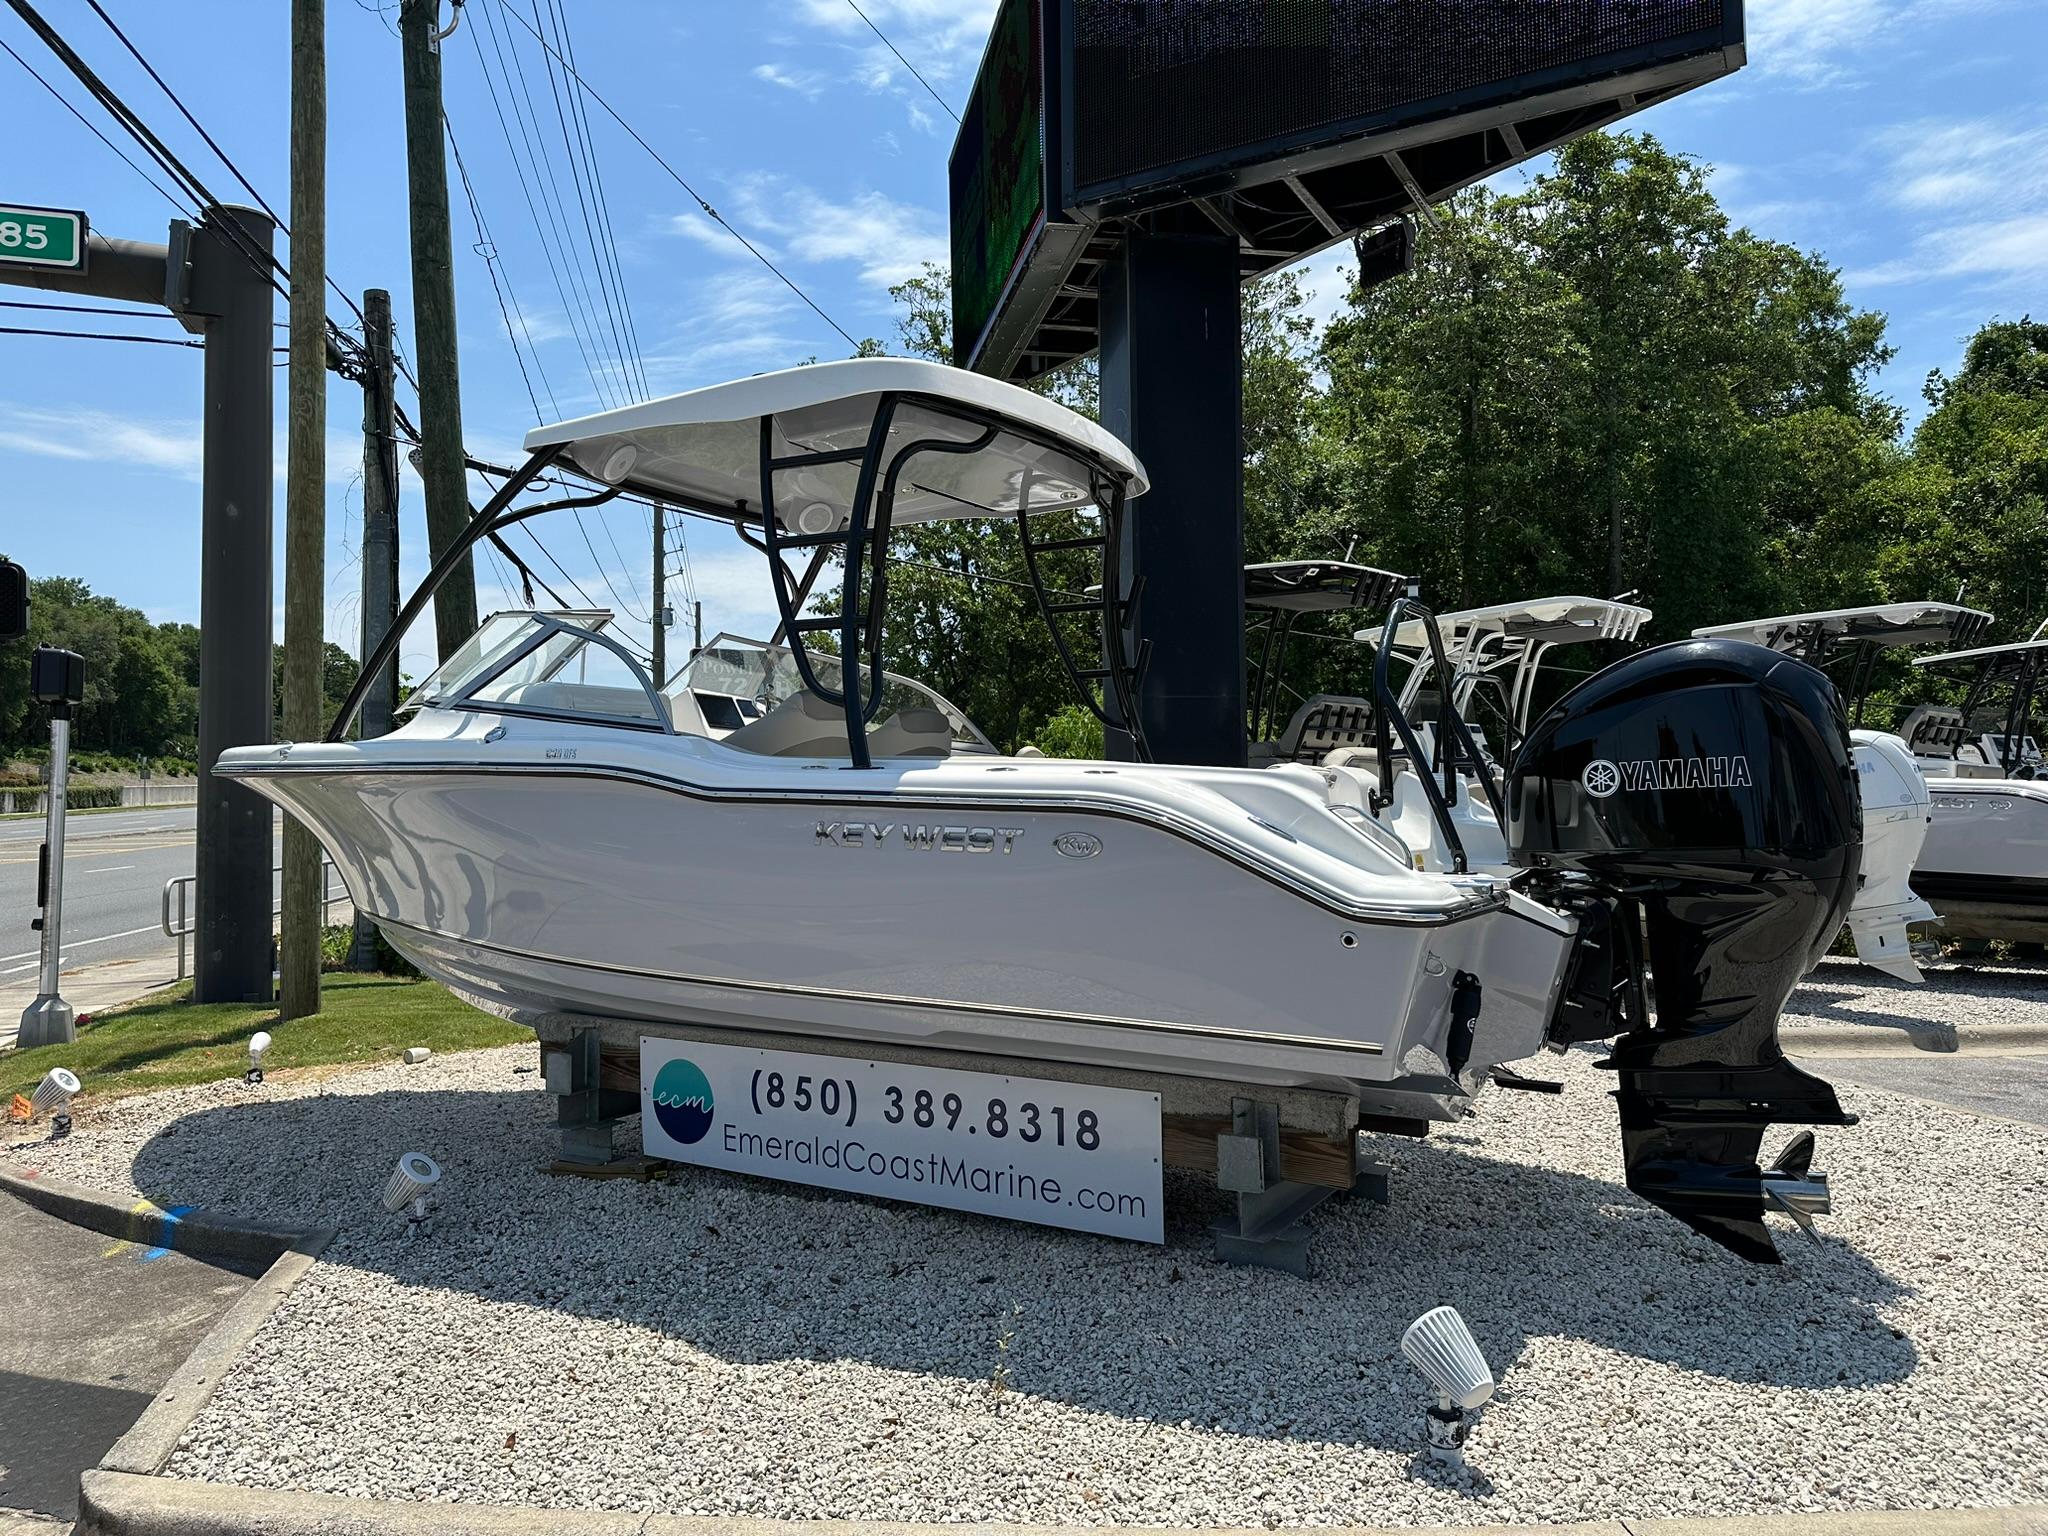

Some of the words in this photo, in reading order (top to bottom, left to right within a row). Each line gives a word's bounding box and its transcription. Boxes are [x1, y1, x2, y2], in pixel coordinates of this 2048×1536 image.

[0, 221, 48, 250] 85
[1618, 756, 1752, 791] YAMAHA
[1931, 798, 1978, 809] EST
[814, 820, 896, 848] KEY
[901, 824, 1024, 855] WEST
[653, 1090, 715, 1114] ecm
[751, 1069, 858, 1127] (850)
[884, 1085, 1101, 1151] 389.8318
[723, 1123, 1147, 1219] EmeraldCoastMarine.com
